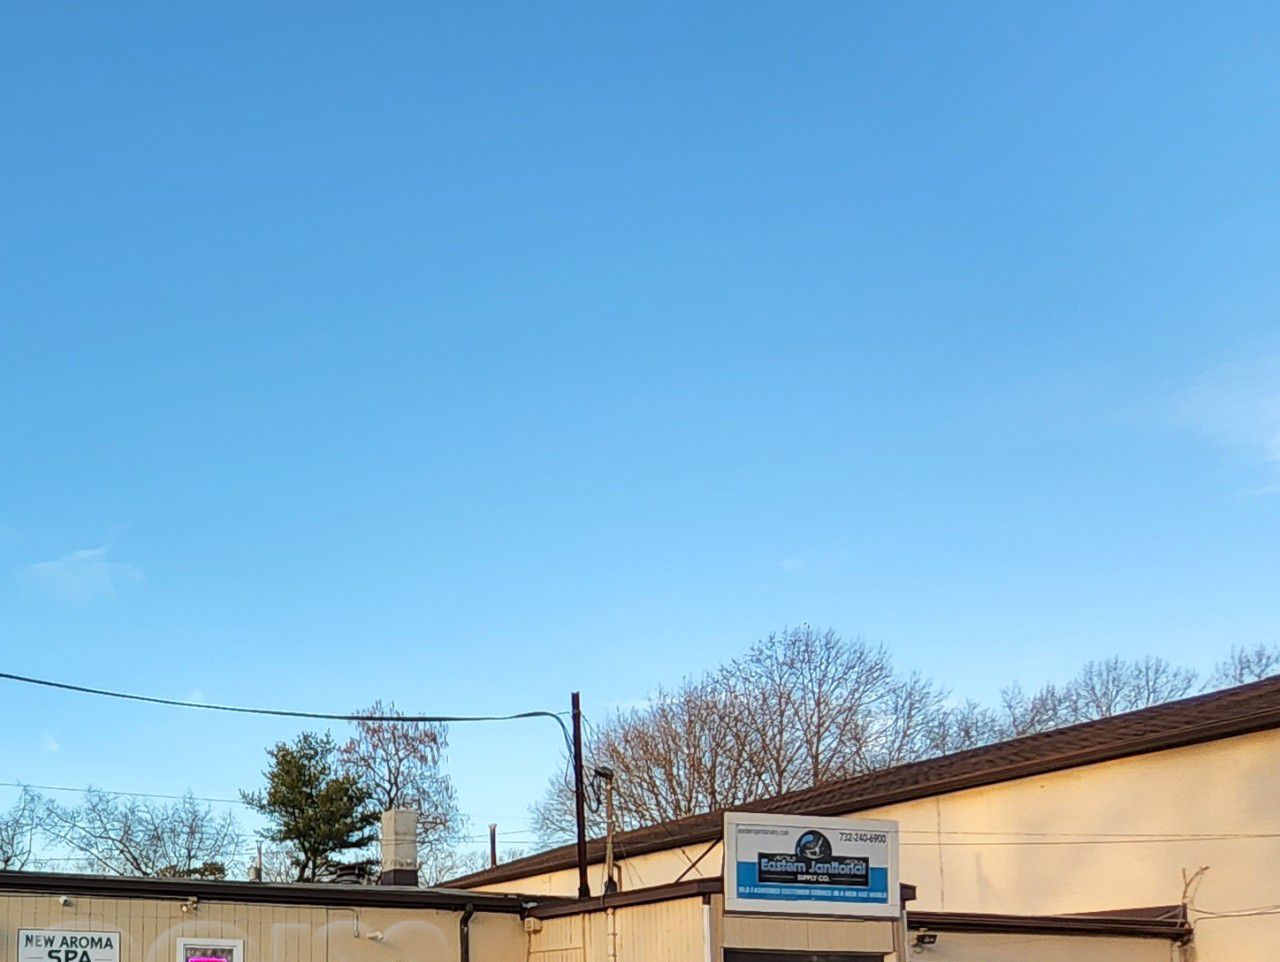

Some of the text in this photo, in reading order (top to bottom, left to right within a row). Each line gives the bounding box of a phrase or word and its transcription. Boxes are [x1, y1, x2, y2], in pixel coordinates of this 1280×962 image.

[760, 858, 866, 875] Eastern Janitorial
[25, 934, 114, 949] NEW AROMA
